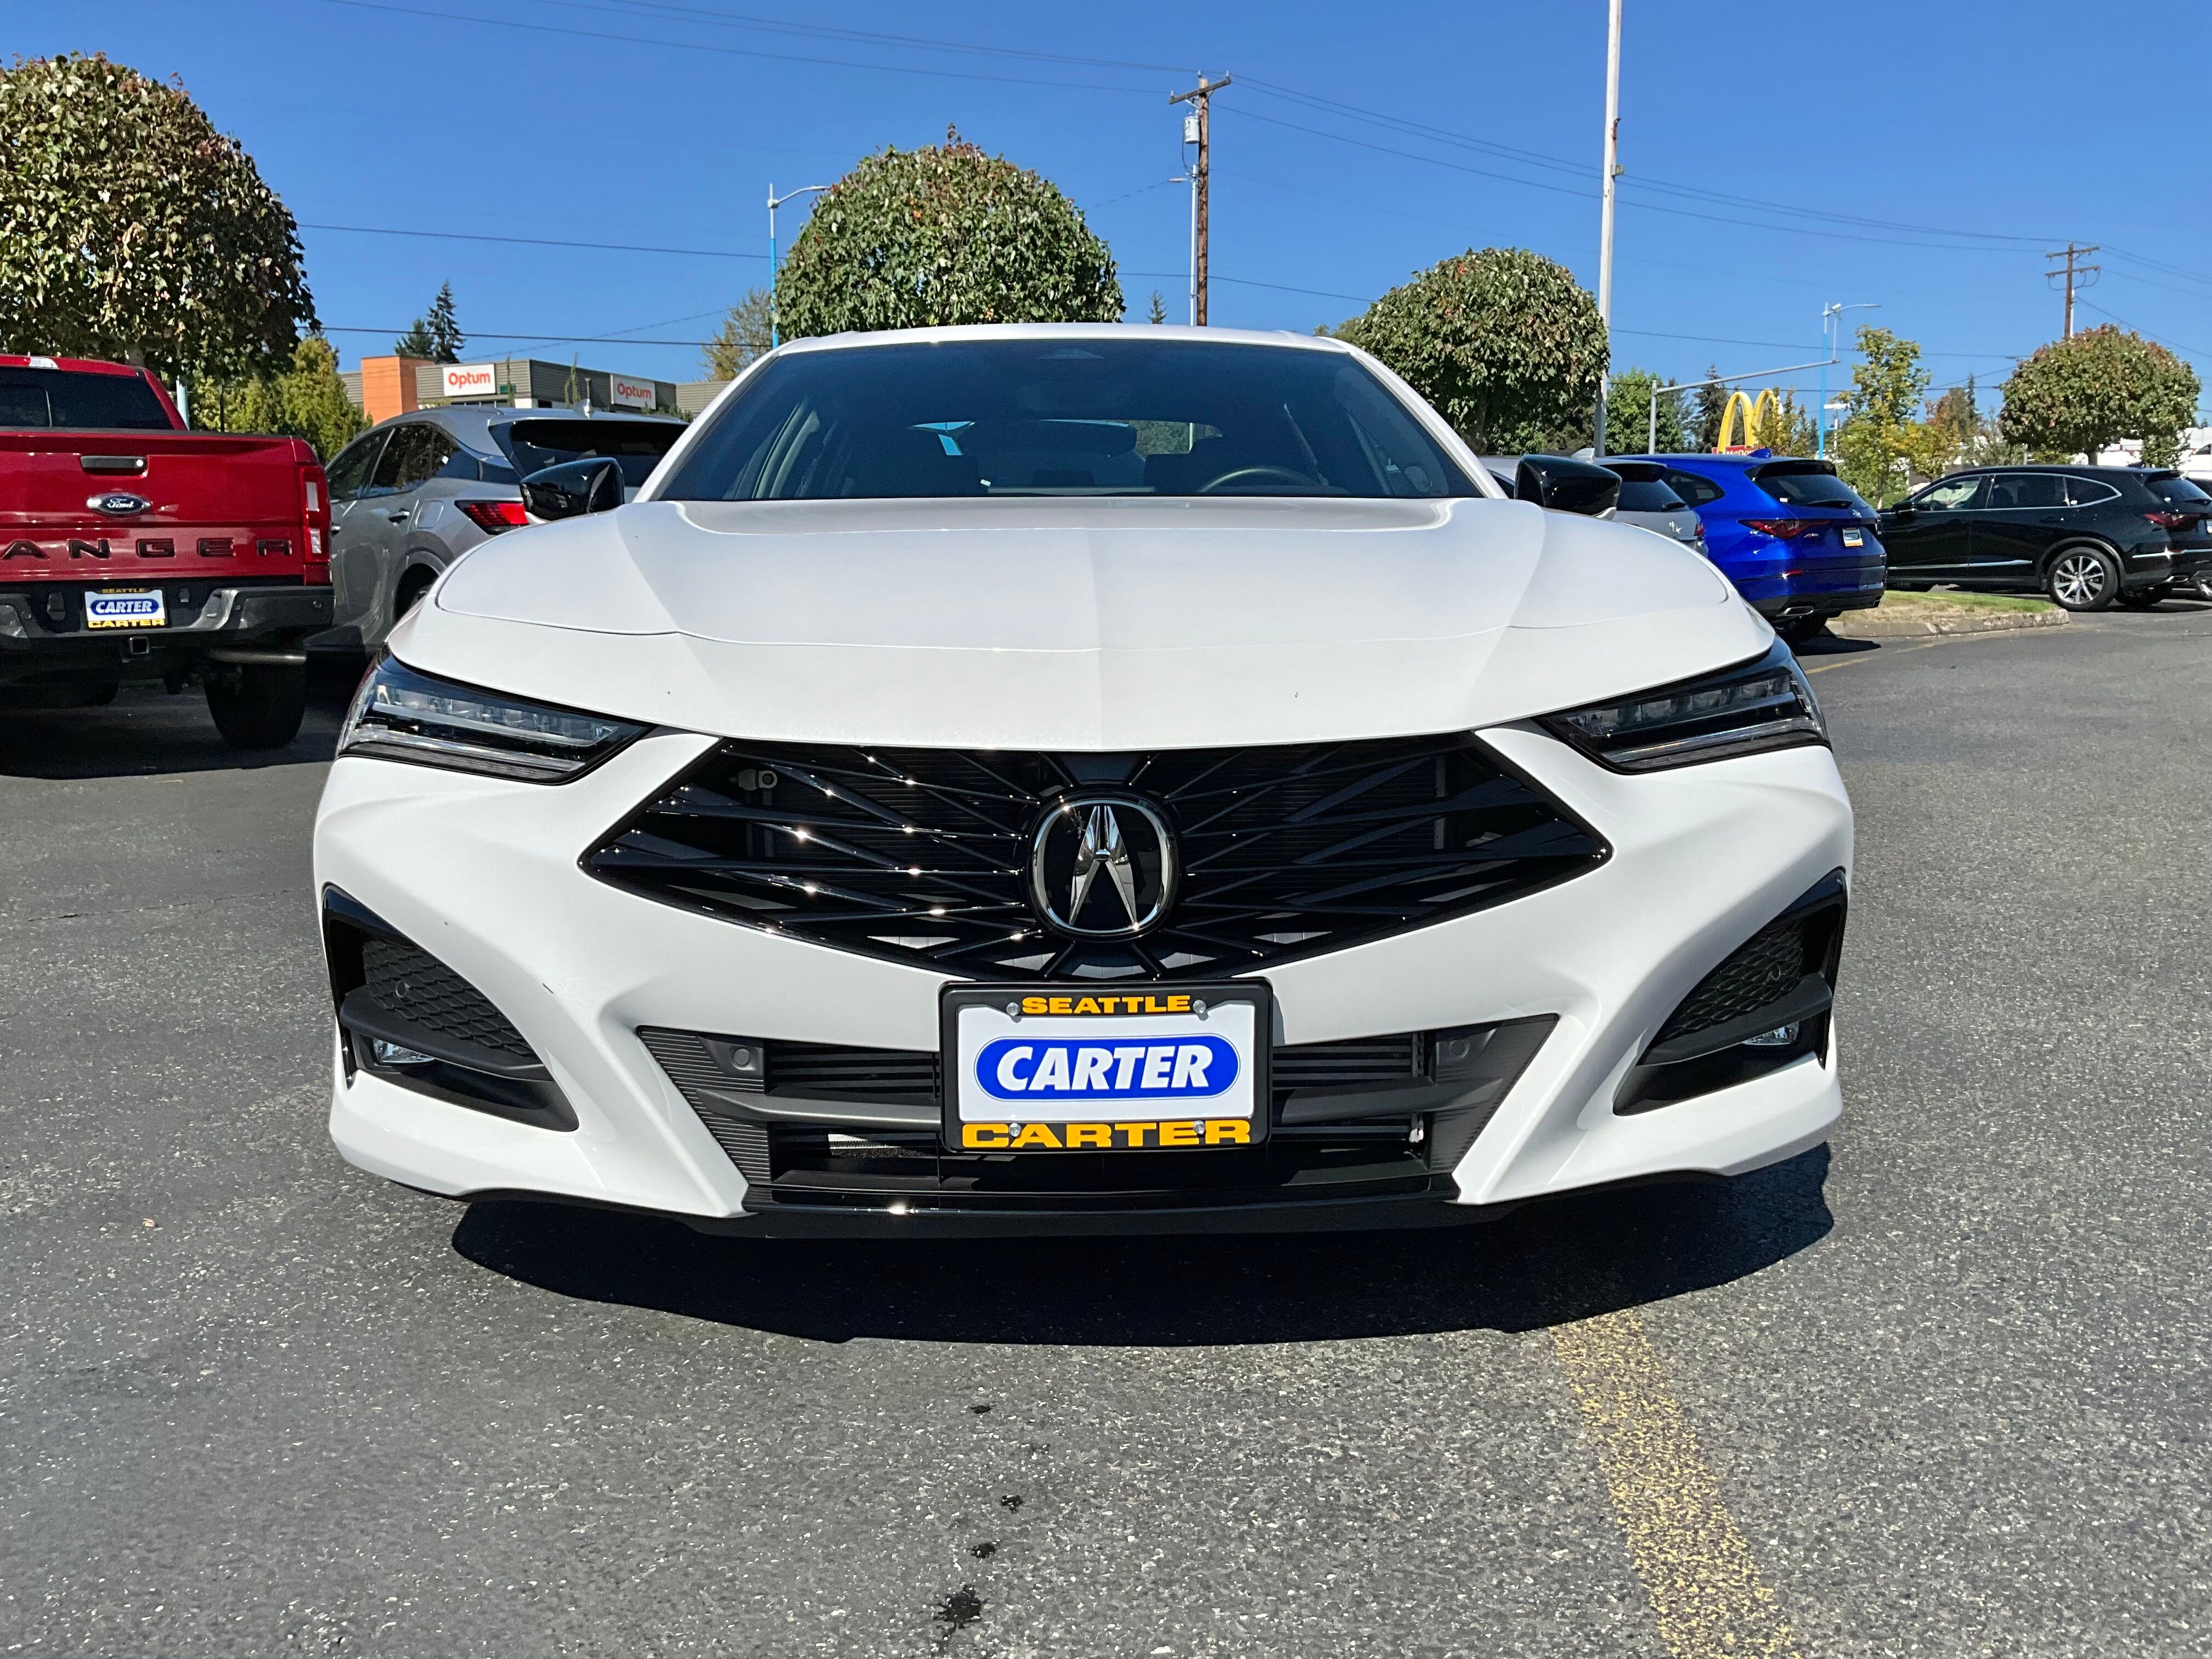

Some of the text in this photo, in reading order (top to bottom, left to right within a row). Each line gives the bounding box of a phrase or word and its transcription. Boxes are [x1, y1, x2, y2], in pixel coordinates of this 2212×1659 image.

[448, 373, 491, 389] Optum
[617, 382, 651, 399] Optum
[106, 498, 134, 508] Ford
[0, 538, 292, 560] ANGER
[95, 600, 153, 613] CARTER
[88, 619, 165, 628] CARTER
[1022, 995, 1191, 1014] SEATTLE
[996, 1044, 1214, 1092] CARTER
[962, 1119, 1251, 1148] CARTER
